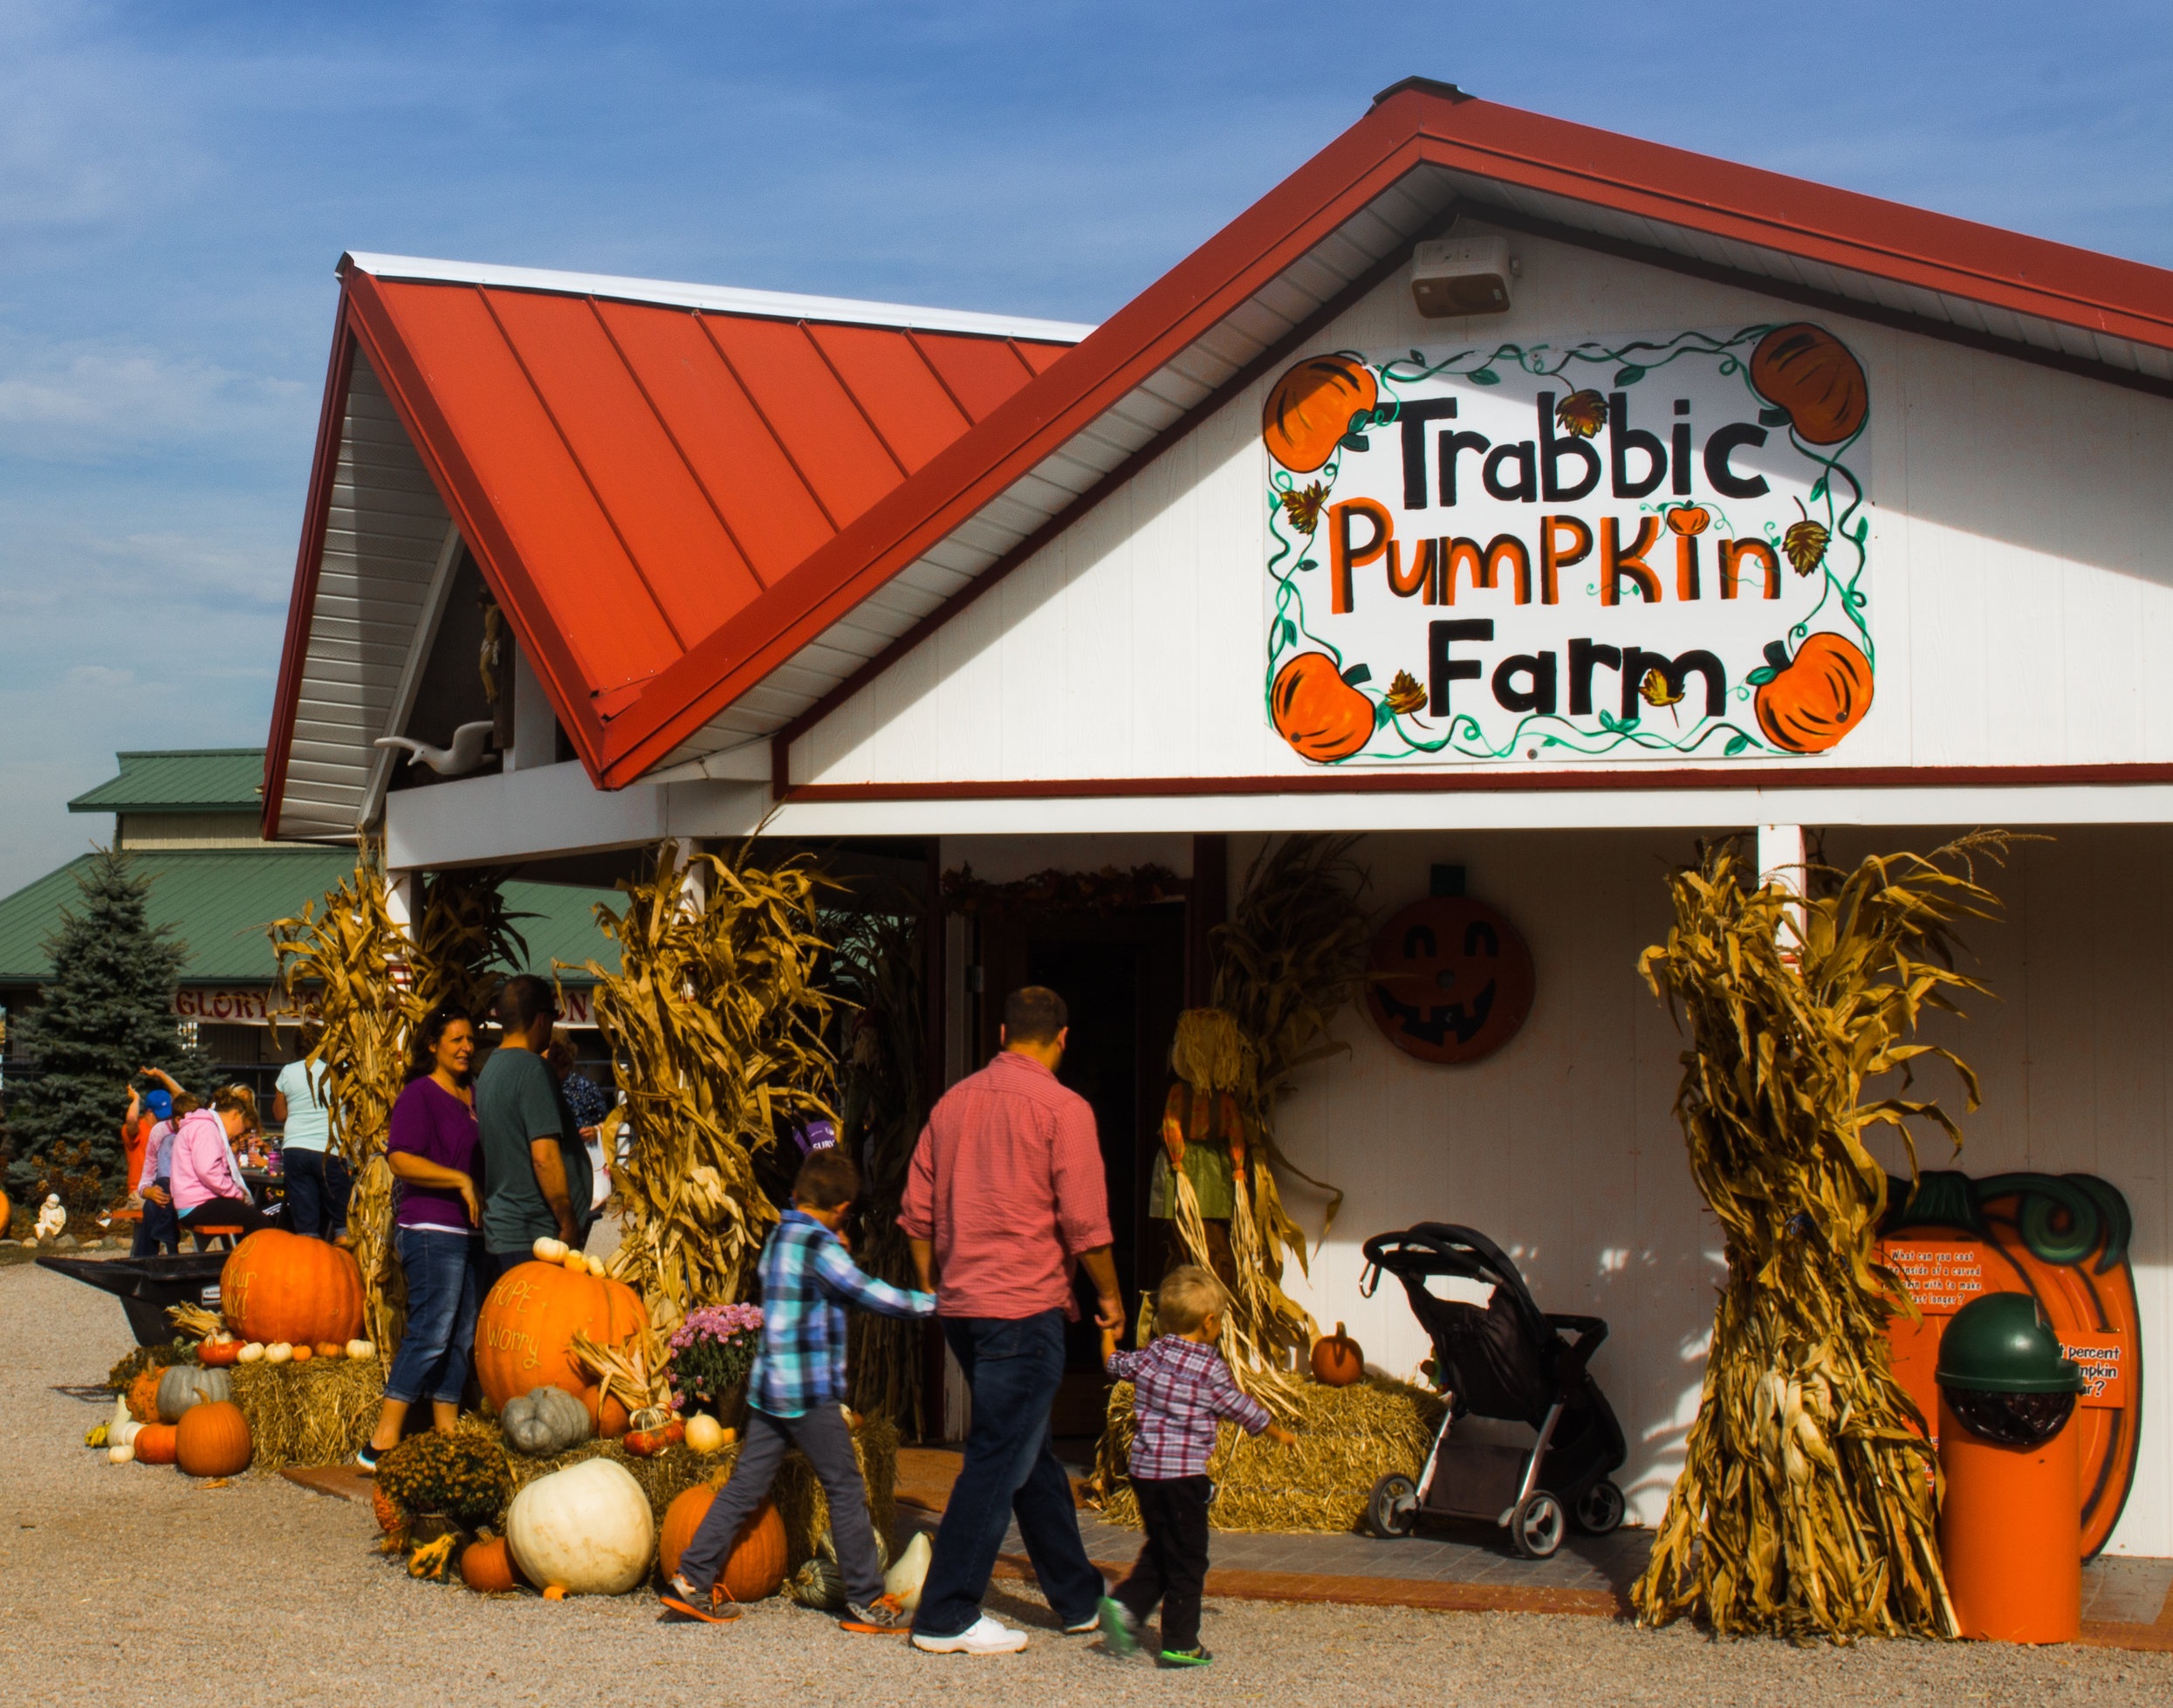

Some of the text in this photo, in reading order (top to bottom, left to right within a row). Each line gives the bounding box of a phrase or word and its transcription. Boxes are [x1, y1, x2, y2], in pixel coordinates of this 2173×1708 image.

[1374, 391, 1770, 510] Trabbic
[1429, 618, 1726, 719] Farm
[176, 991, 271, 1019] GLORY
[1891, 1250, 1915, 1260] What
[1937, 1252, 1951, 1263] you
[1955, 1251, 1974, 1260] coat
[1902, 1265, 1928, 1274] inside
[1932, 1264, 1942, 1274] of
[1952, 1265, 1981, 1275] carved
[229, 1262, 257, 1288] Your
[1923, 1279, 1943, 1289] with
[1947, 1280, 1955, 1289] to
[1959, 1279, 1981, 1290] make
[487, 1320, 542, 1370] Worry
[2068, 1347, 2120, 1361] percent
